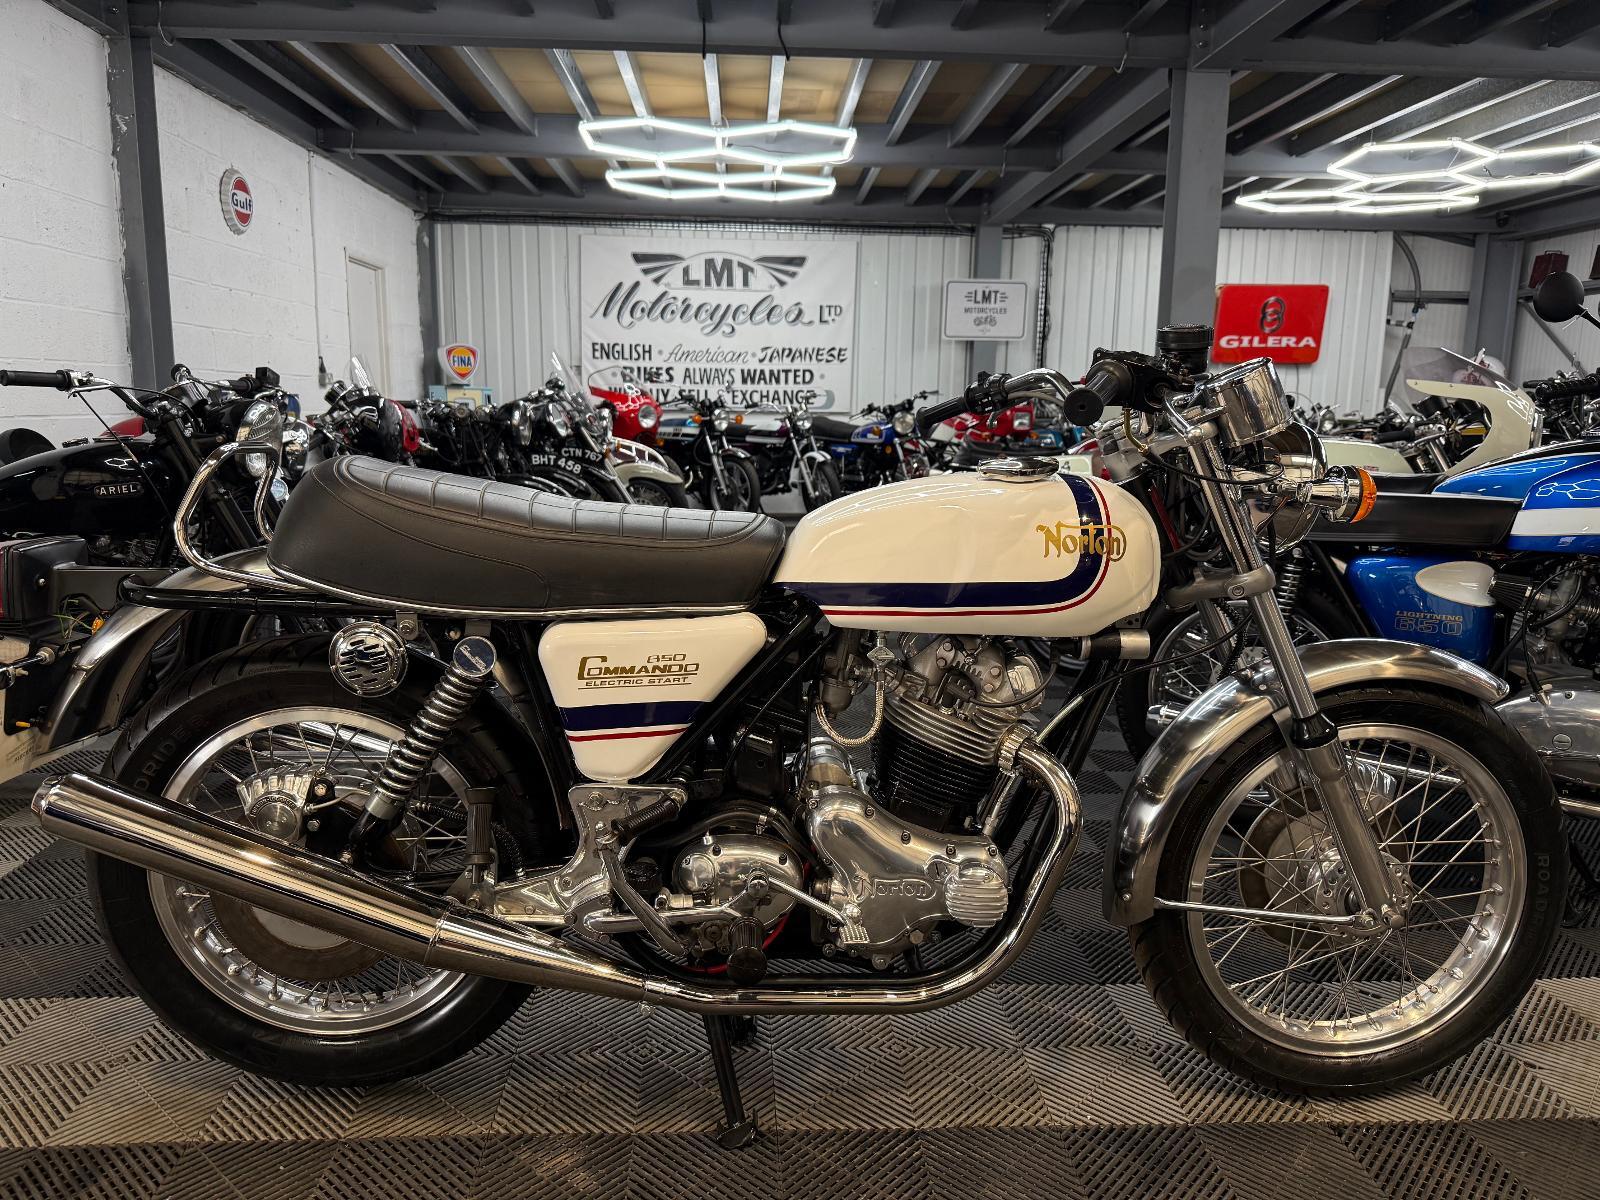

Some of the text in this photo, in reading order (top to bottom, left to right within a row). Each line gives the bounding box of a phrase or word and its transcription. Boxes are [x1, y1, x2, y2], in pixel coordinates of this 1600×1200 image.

[231, 192, 252, 212] Gulf
[682, 257, 756, 288] LMT
[973, 289, 1000, 305] LMT
[590, 280, 814, 337] Motorcycles
[963, 307, 1008, 315] MOTORCYCLES
[1219, 335, 1317, 349] GILERA
[452, 355, 473, 368] FINA
[591, 342, 849, 364] ENGLISH American JAPANESE
[682, 367, 736, 385] ALWAYS
[740, 368, 815, 385] WANTED
[731, 389, 816, 405] EXCHANGE
[560, 447, 603, 463] CTN 767
[531, 454, 582, 475] BHT 458
[99, 484, 137, 496] ARIEL
[1035, 520, 1127, 562] Norton
[1395, 610, 1464, 621] LIGHTNING
[1394, 617, 1463, 636] 650
[646, 653, 687, 664] 850
[577, 655, 700, 681] COMMANDO
[585, 676, 689, 687] ELECTRIC START
[853, 876, 937, 902] Norton
